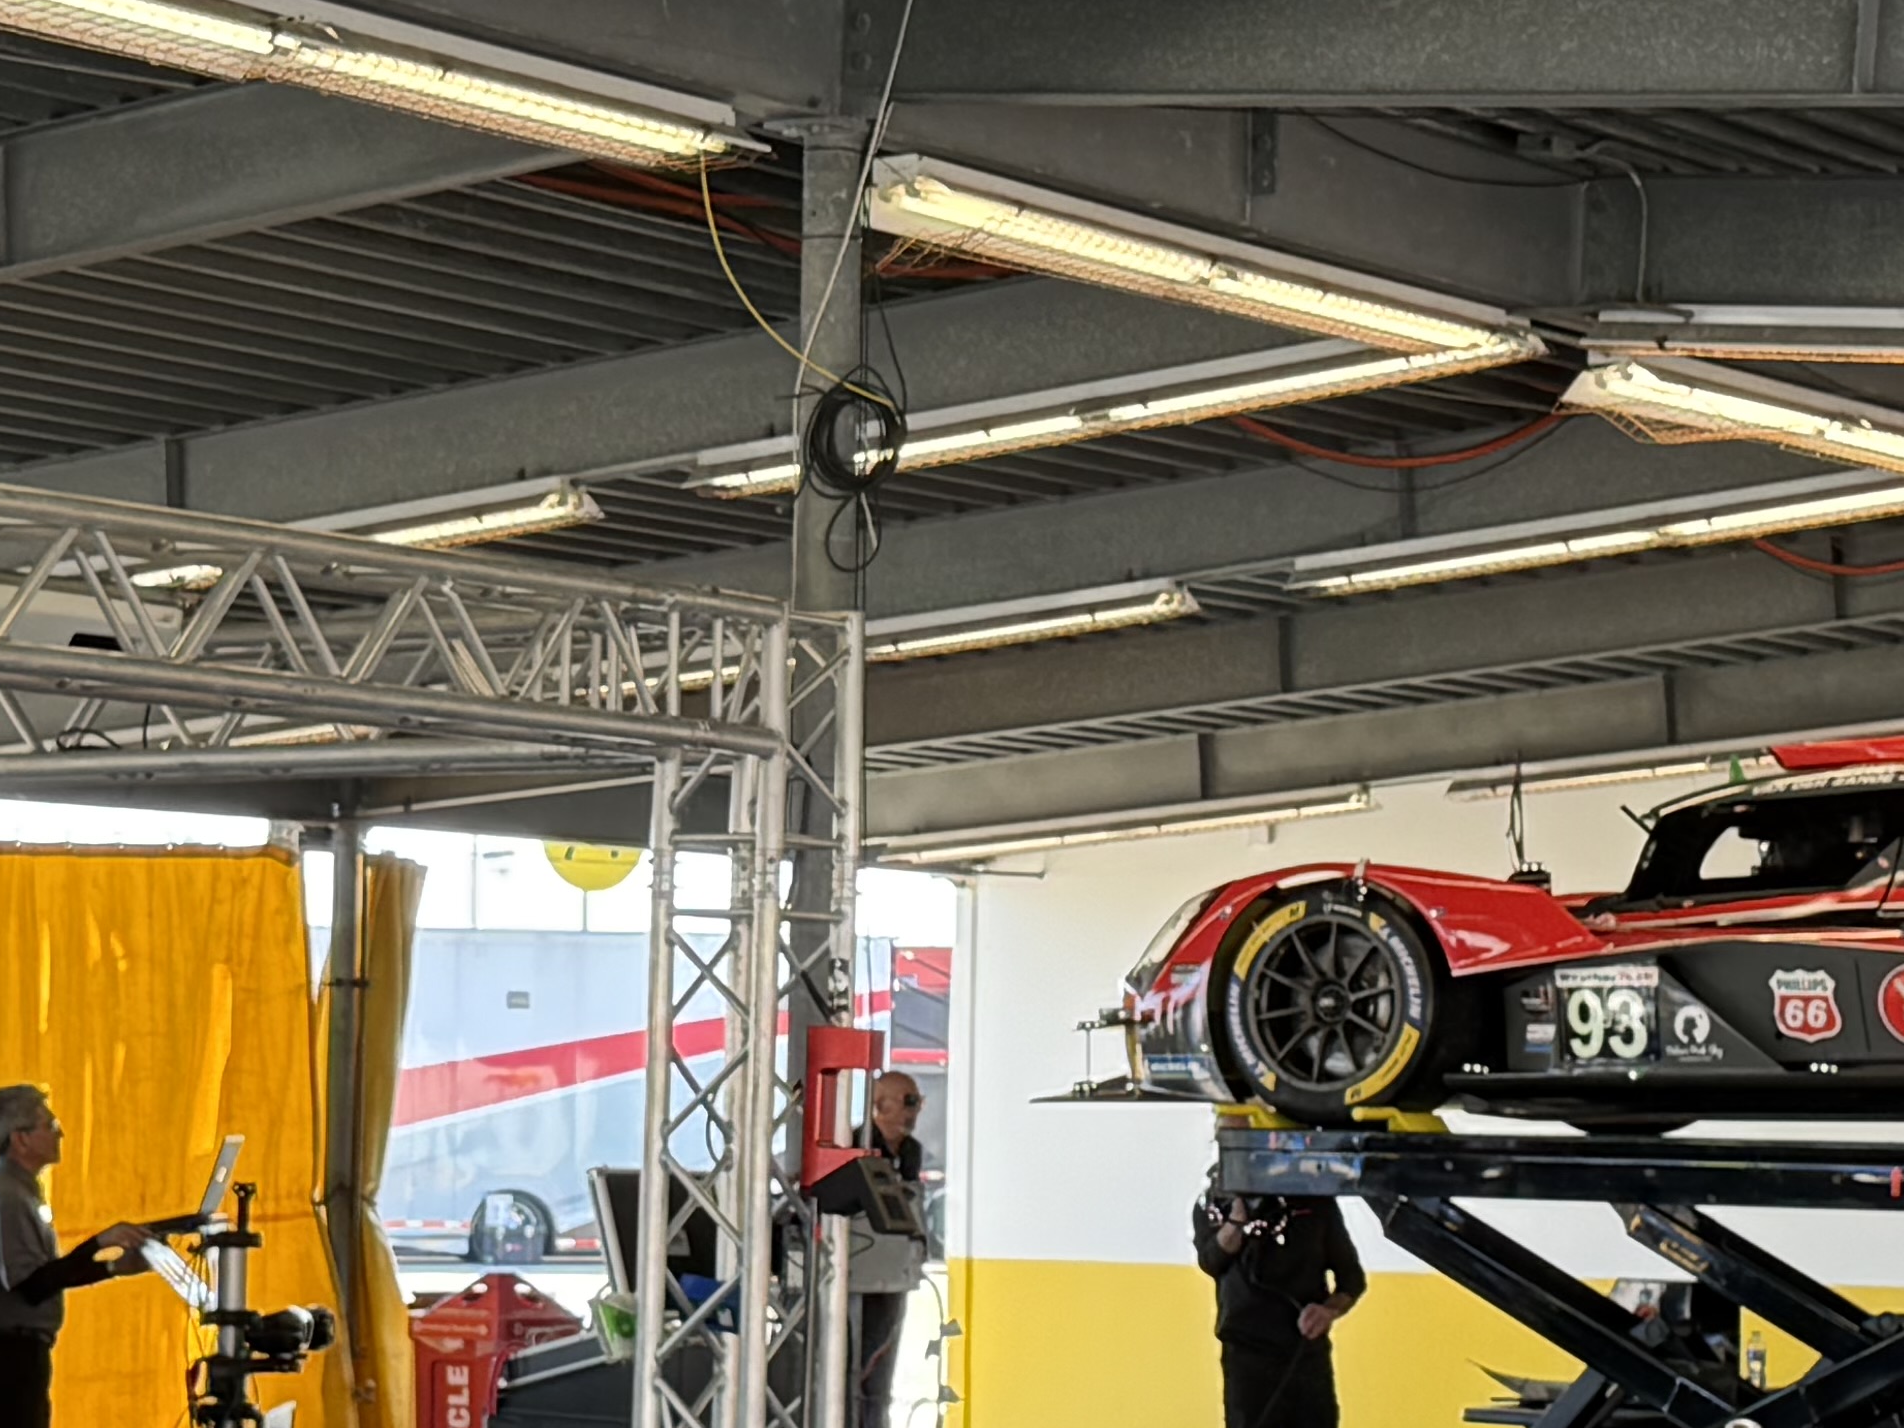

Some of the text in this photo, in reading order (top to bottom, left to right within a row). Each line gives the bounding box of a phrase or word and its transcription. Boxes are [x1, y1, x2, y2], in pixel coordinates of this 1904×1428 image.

[1776, 978, 1829, 992] PHILLIPS
[1567, 988, 1648, 1059] 93
[1784, 998, 1828, 1029] 66
